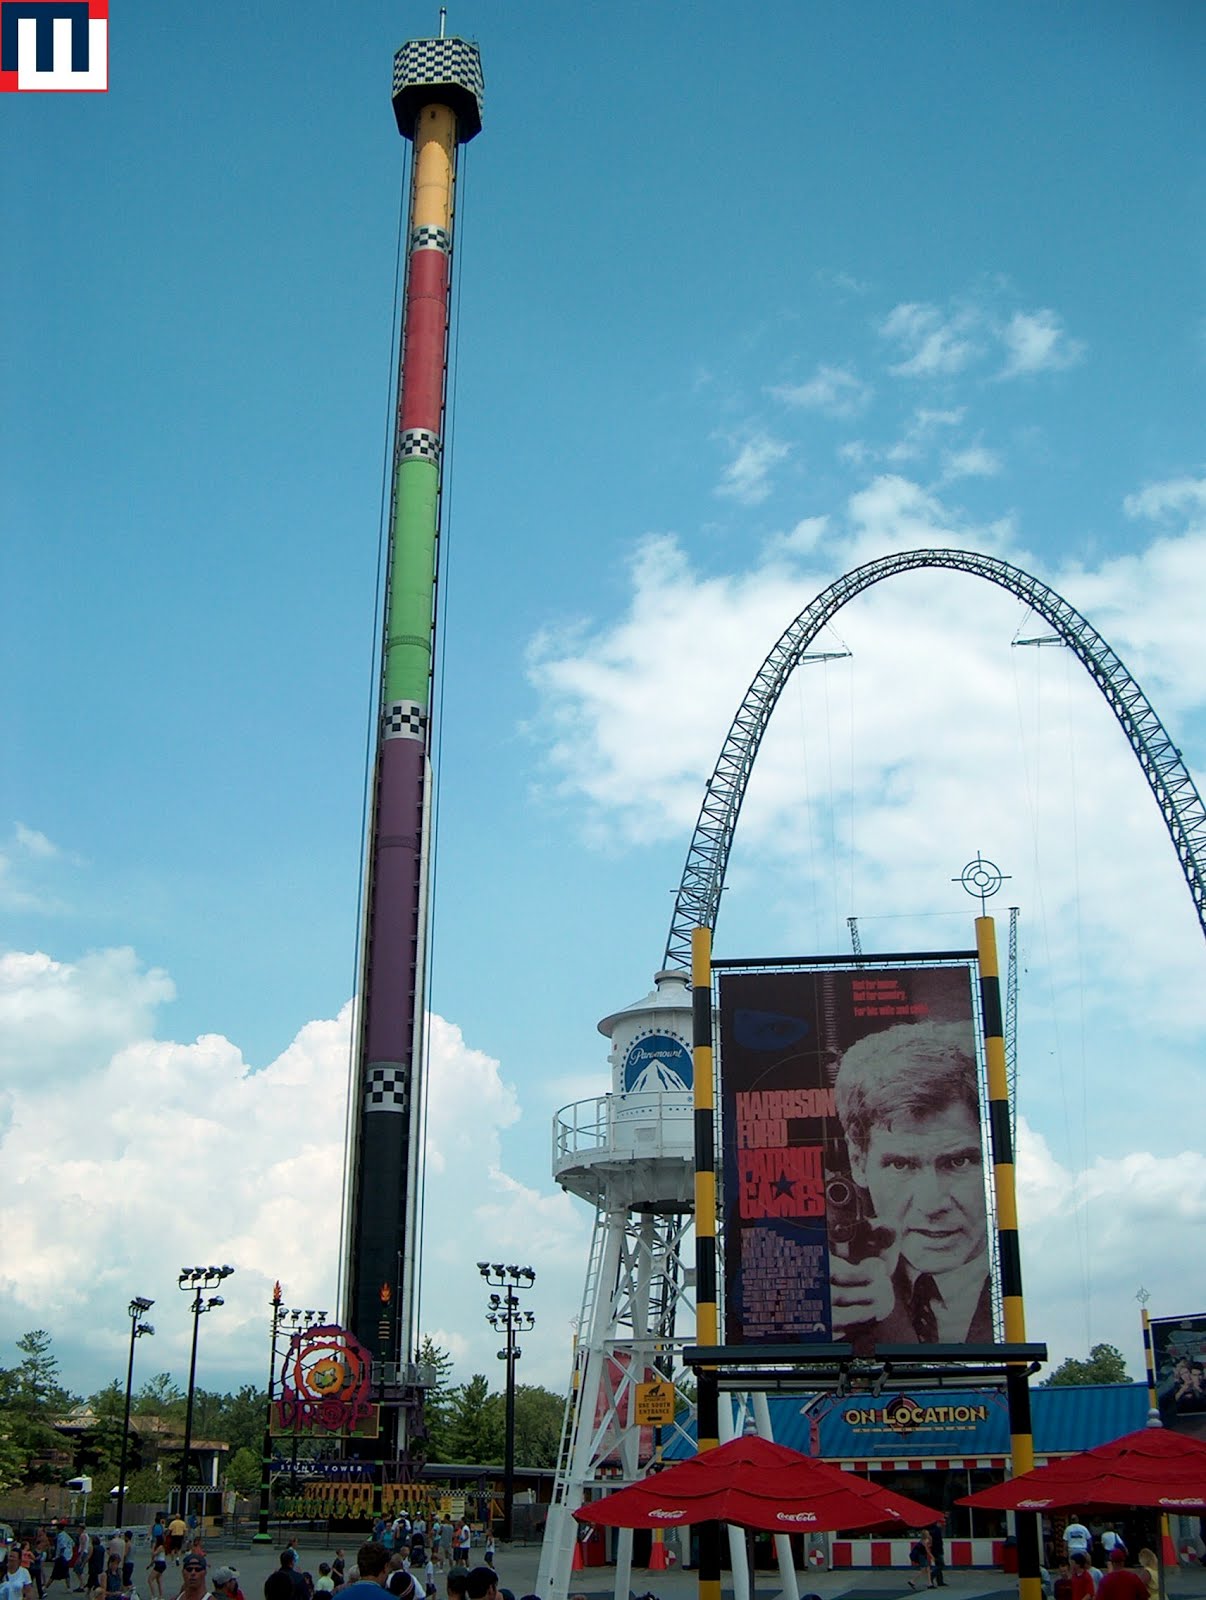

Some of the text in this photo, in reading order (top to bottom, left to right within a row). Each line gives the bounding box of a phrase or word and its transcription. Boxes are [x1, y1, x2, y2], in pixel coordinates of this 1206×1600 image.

[629, 1047, 683, 1066] Paramount
[736, 1088, 836, 1120] HARRISON
[737, 1119, 788, 1150] FORD
[738, 1146, 824, 1184] PATRIOT
[739, 1180, 826, 1219] GAMES
[845, 1405, 987, 1425] ON LOCATION
[323, 1464, 363, 1472] TOWER
[776, 1512, 817, 1522] Coca-Cola
